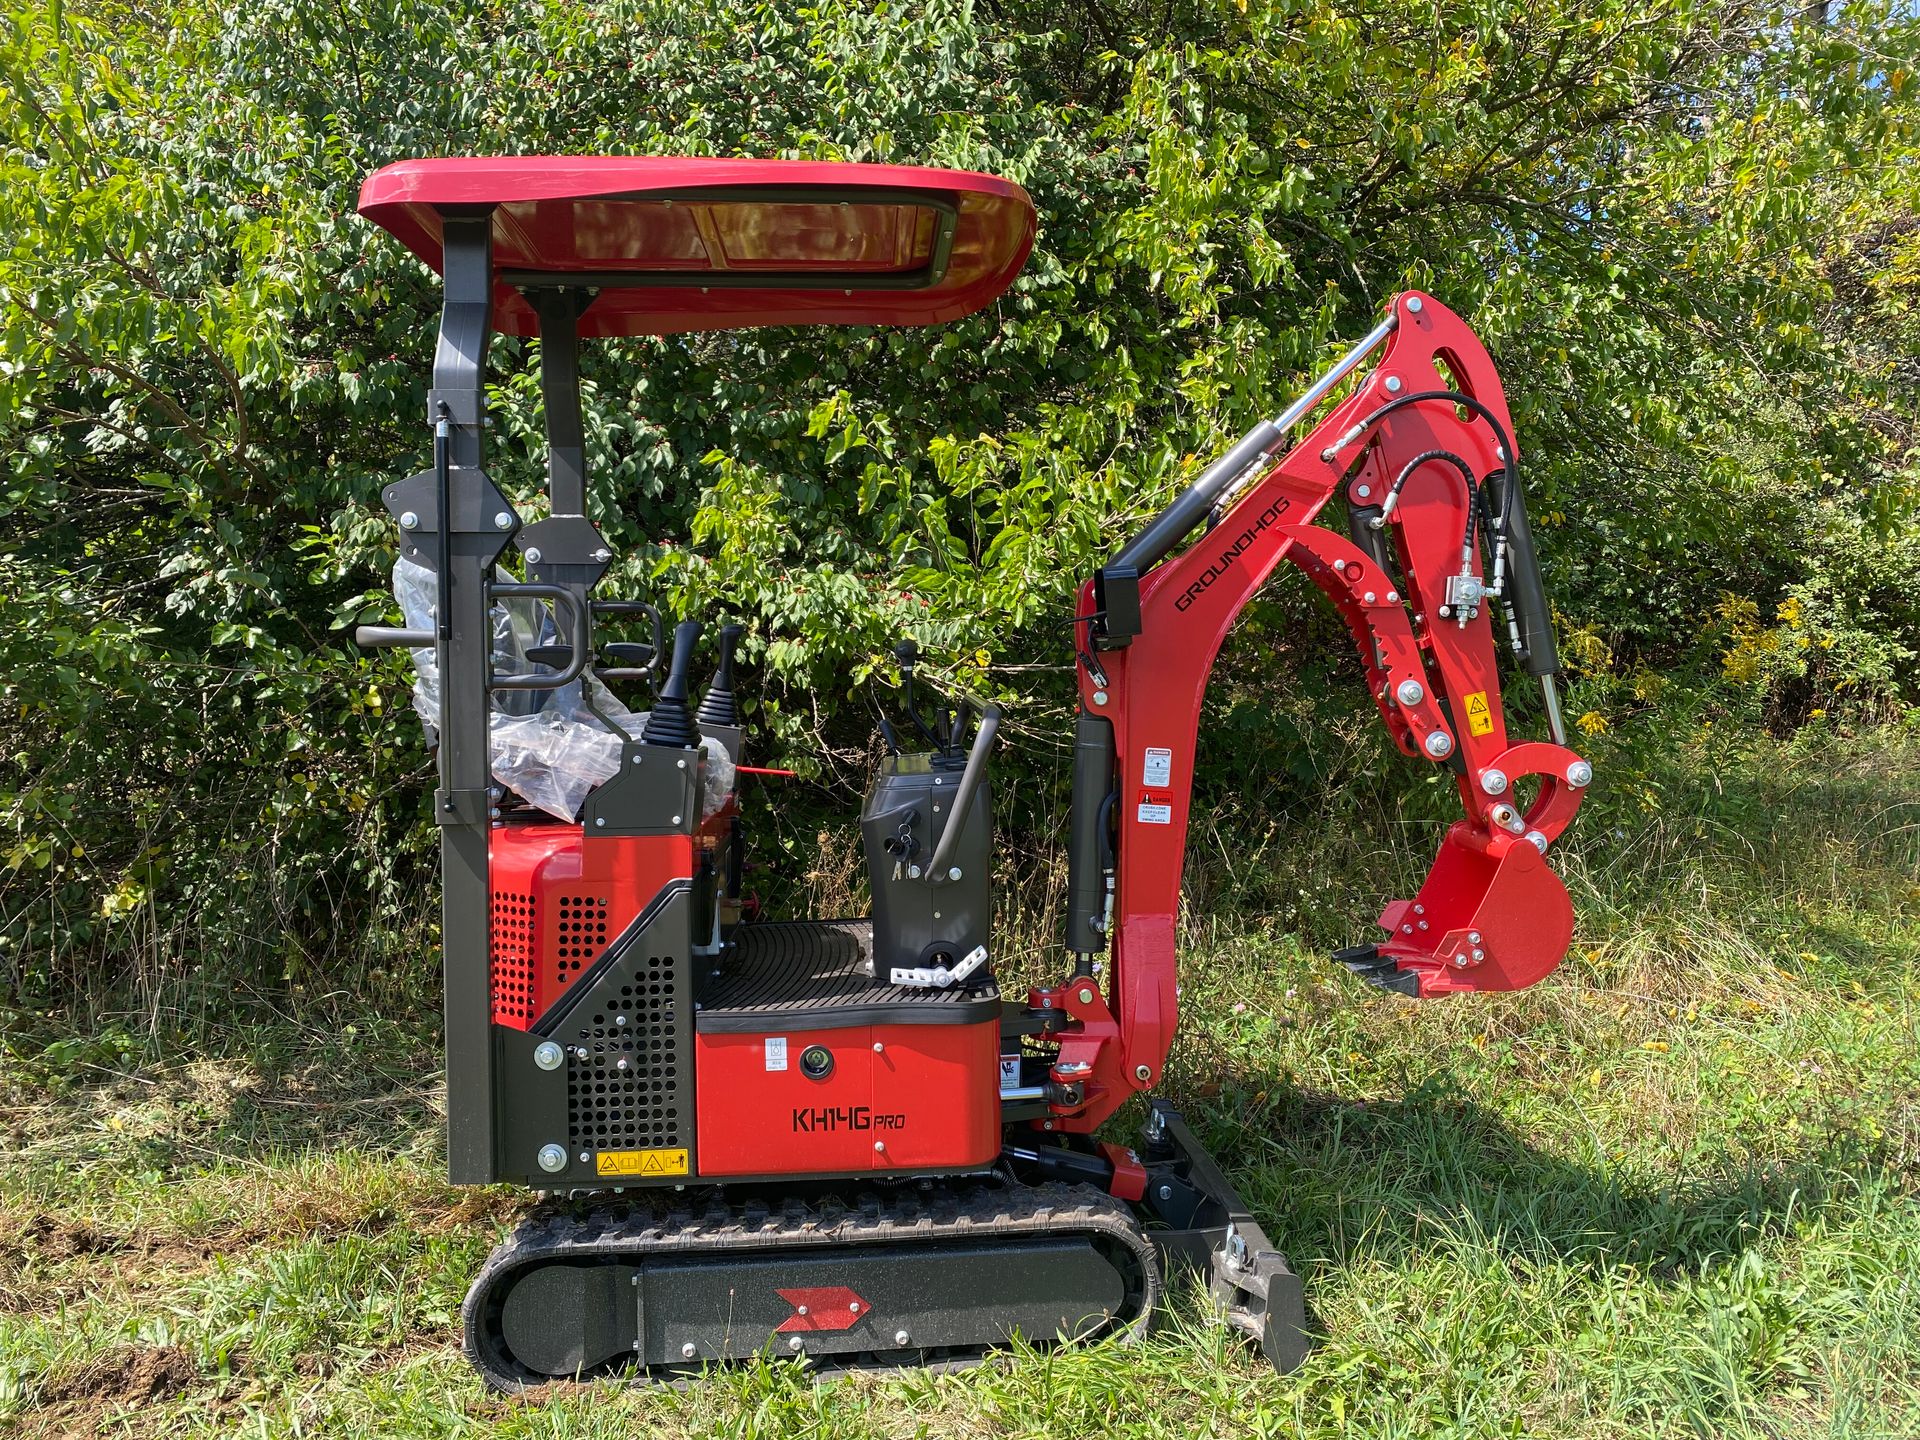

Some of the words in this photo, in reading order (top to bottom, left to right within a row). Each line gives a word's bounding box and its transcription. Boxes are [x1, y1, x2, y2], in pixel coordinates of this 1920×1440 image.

[1174, 496, 1290, 612] GROUNDHOG
[793, 1106, 870, 1132] KH14G
[873, 1114, 906, 1130] PRO
